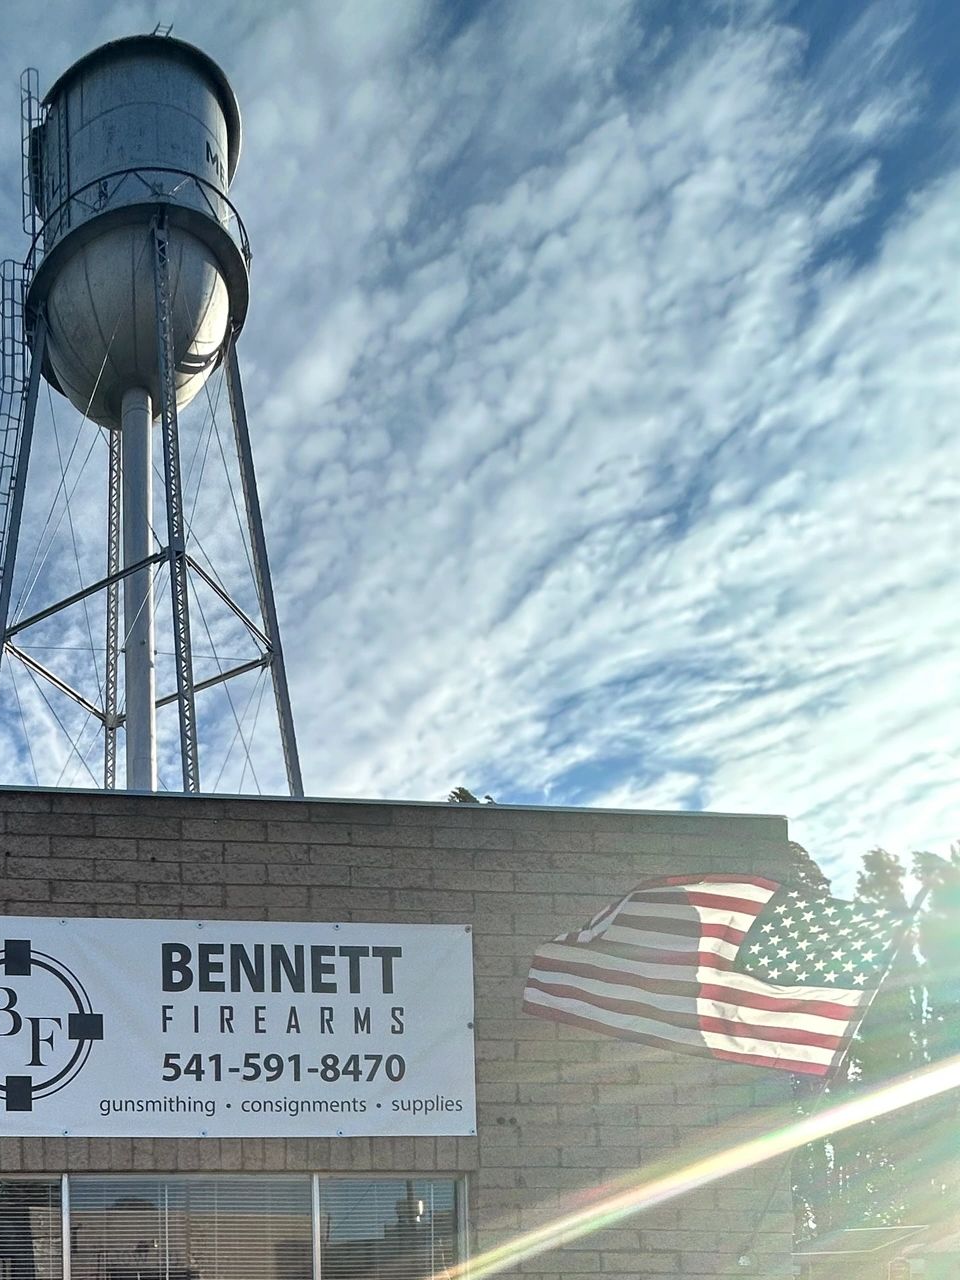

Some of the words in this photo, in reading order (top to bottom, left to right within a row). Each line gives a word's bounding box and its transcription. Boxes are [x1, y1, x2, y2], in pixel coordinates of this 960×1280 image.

[161, 942, 403, 994] BENNETT
[161, 1004, 404, 1035] FIREARMS
[162, 1052, 406, 1083] 541-591-8470
[99, 1095, 216, 1117] gunsmithing
[241, 1096, 367, 1117] consignments
[391, 1094, 463, 1116] supplies
